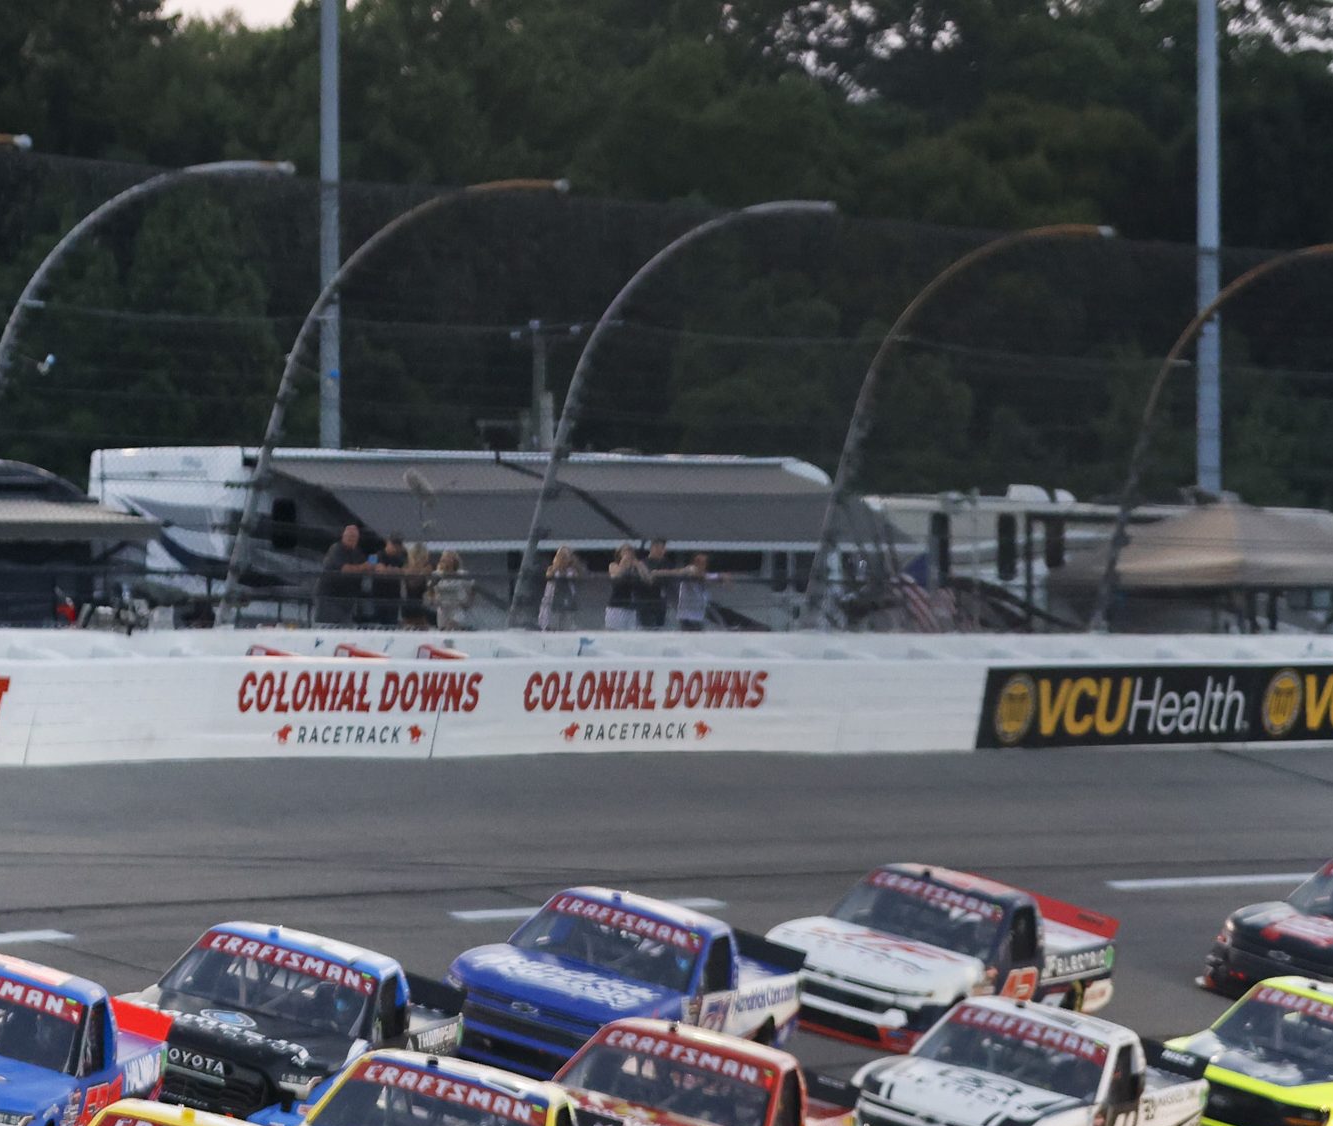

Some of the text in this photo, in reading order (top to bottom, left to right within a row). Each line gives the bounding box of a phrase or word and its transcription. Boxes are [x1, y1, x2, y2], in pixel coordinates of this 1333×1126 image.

[238, 670, 483, 714] COLONIAL DOWNS
[523, 670, 768, 711] COLONIAL DOWNS
[296, 723, 402, 745] RACETRACK
[583, 720, 687, 741] RACETRACK
[556, 895, 688, 946] CRAFTSMAN
[210, 933, 360, 987] CRAFTSMAN
[168, 1047, 225, 1076] OYOTA
[605, 1029, 759, 1083] CRAFTSMAN
[364, 1064, 535, 1123] CRAFTSMAN
